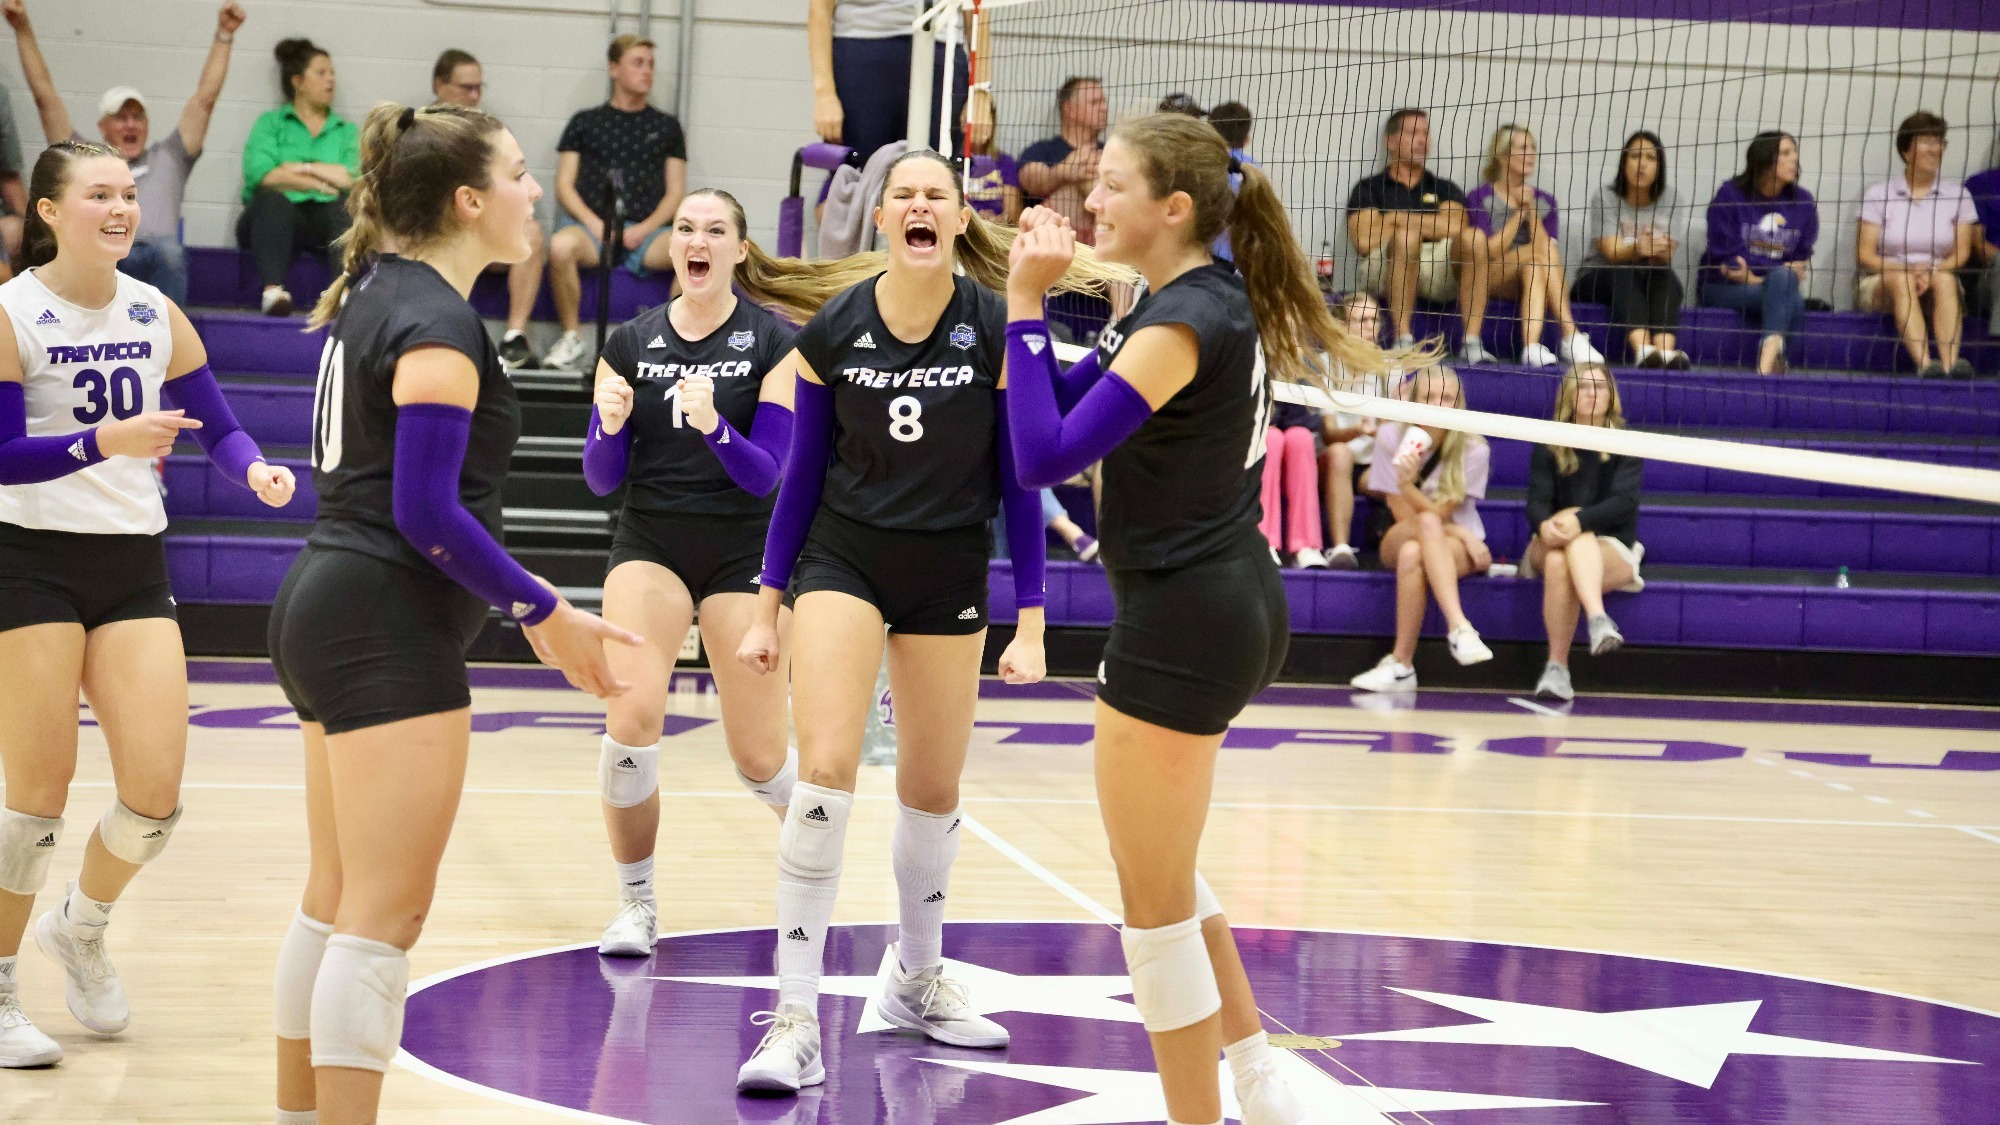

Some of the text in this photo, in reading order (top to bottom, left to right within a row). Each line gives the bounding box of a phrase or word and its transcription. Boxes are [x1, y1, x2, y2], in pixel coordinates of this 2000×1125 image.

[36, 317, 61, 325] adidas
[46, 341, 152, 364] TREVECCA
[853, 341, 877, 349] adidas
[636, 361, 752, 378] TREVECCA
[842, 365, 974, 388] TREVECCA
[73, 366, 143, 424] 30
[888, 395, 924, 443] 8
[805, 813, 829, 822] adidas
[786, 933, 809, 942] adidas
